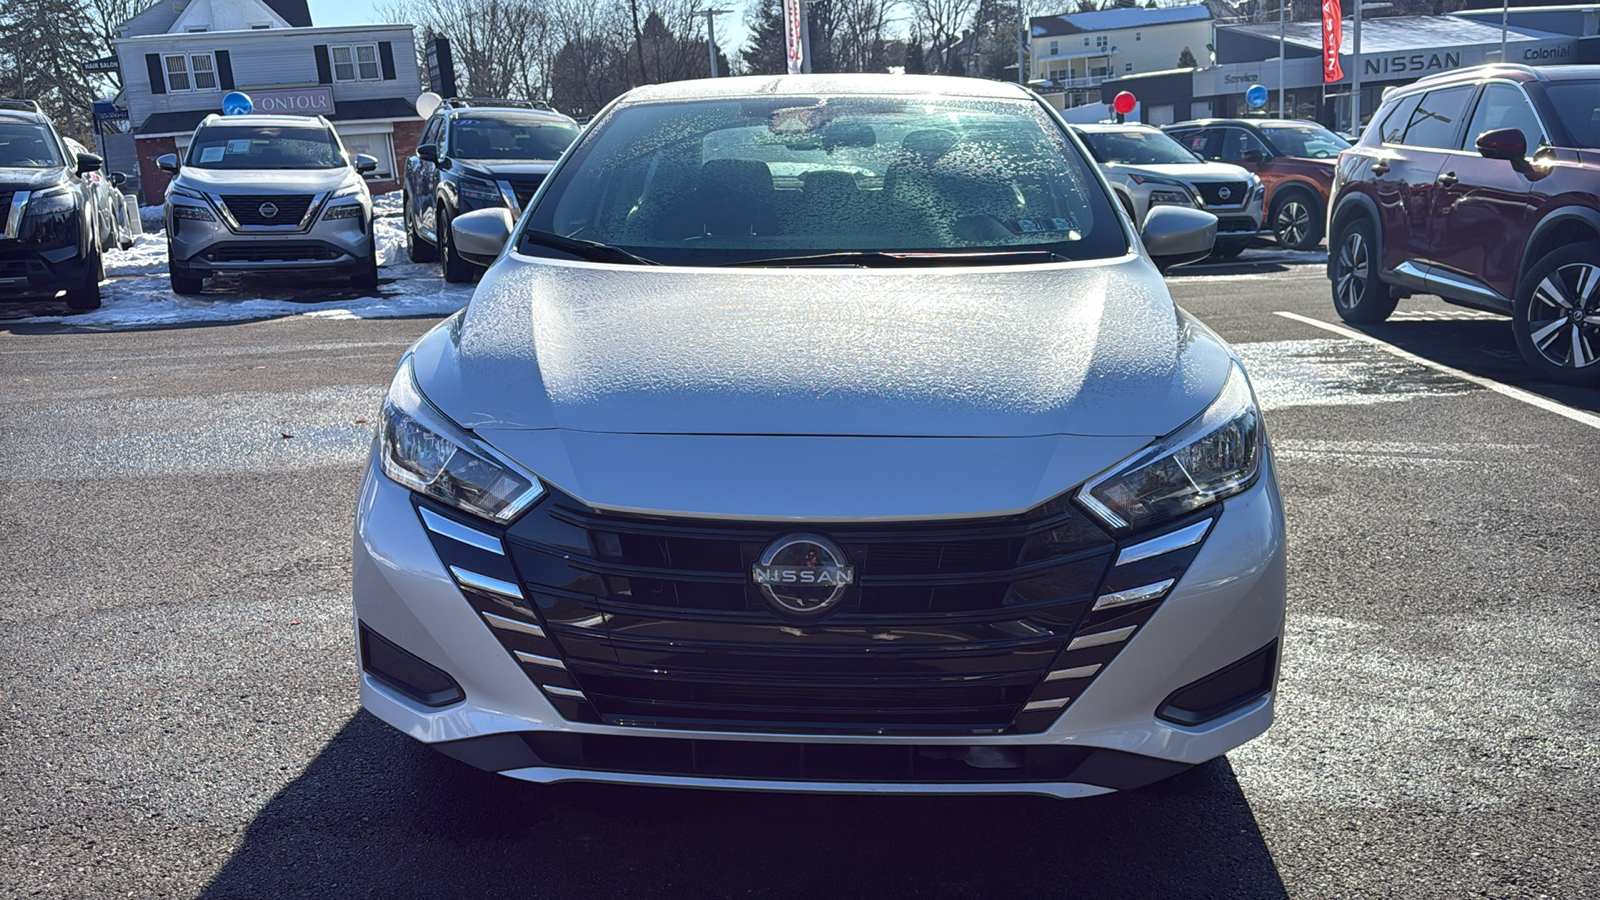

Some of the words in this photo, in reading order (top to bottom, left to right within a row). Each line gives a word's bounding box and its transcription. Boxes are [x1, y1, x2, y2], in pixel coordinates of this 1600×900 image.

[1524, 45, 1570, 60] Colonial
[100, 61, 119, 69] SALON
[1364, 52, 1460, 75] NISSAN
[1224, 72, 1258, 84] Service
[252, 94, 327, 111] CONTOUR
[755, 568, 852, 583] NISSAN
